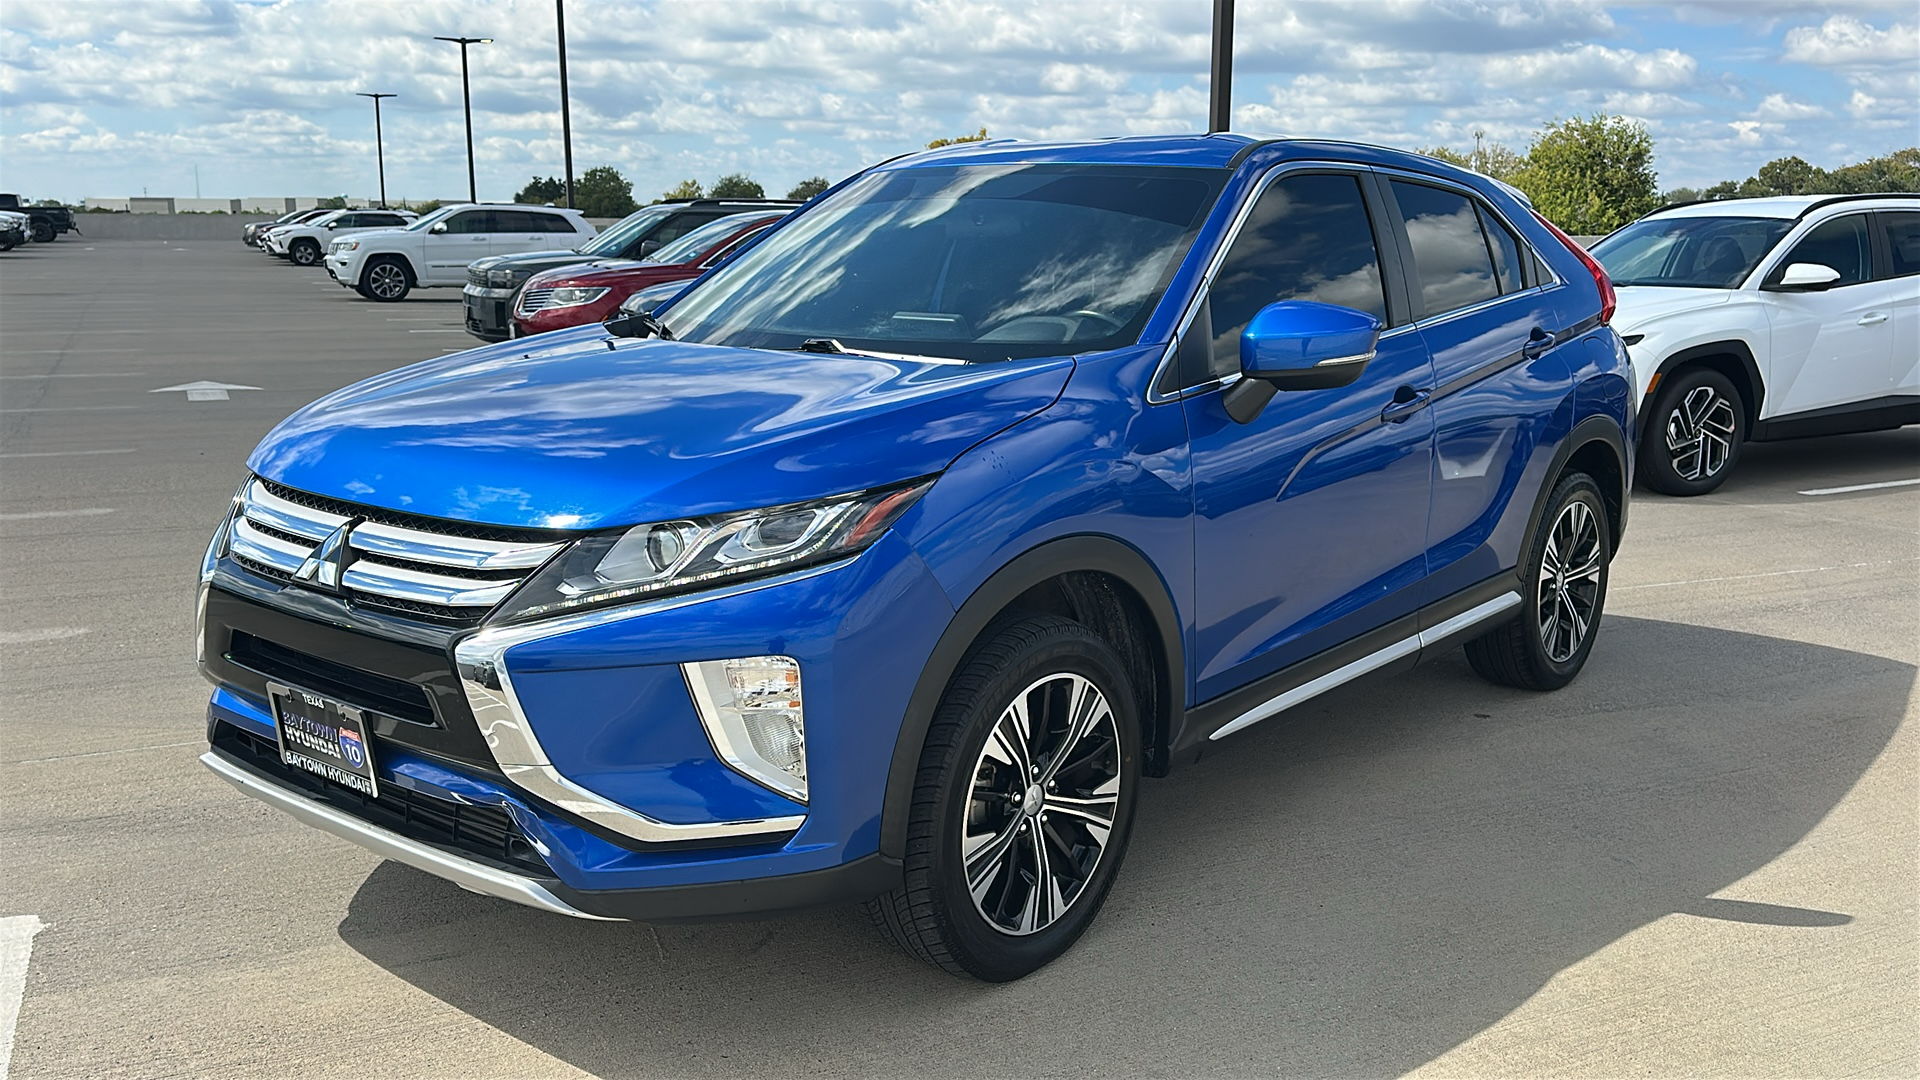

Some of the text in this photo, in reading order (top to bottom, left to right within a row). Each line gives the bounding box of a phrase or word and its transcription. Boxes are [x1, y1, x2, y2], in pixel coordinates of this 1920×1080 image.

[302, 693, 324, 709] TEXAS
[283, 711, 338, 742] BAYTOWN
[284, 724, 341, 759] HYUNDAI
[345, 744, 361, 763] 10
[286, 752, 328, 777] BAYTOWN
[328, 767, 366, 792] HYUNDAI
